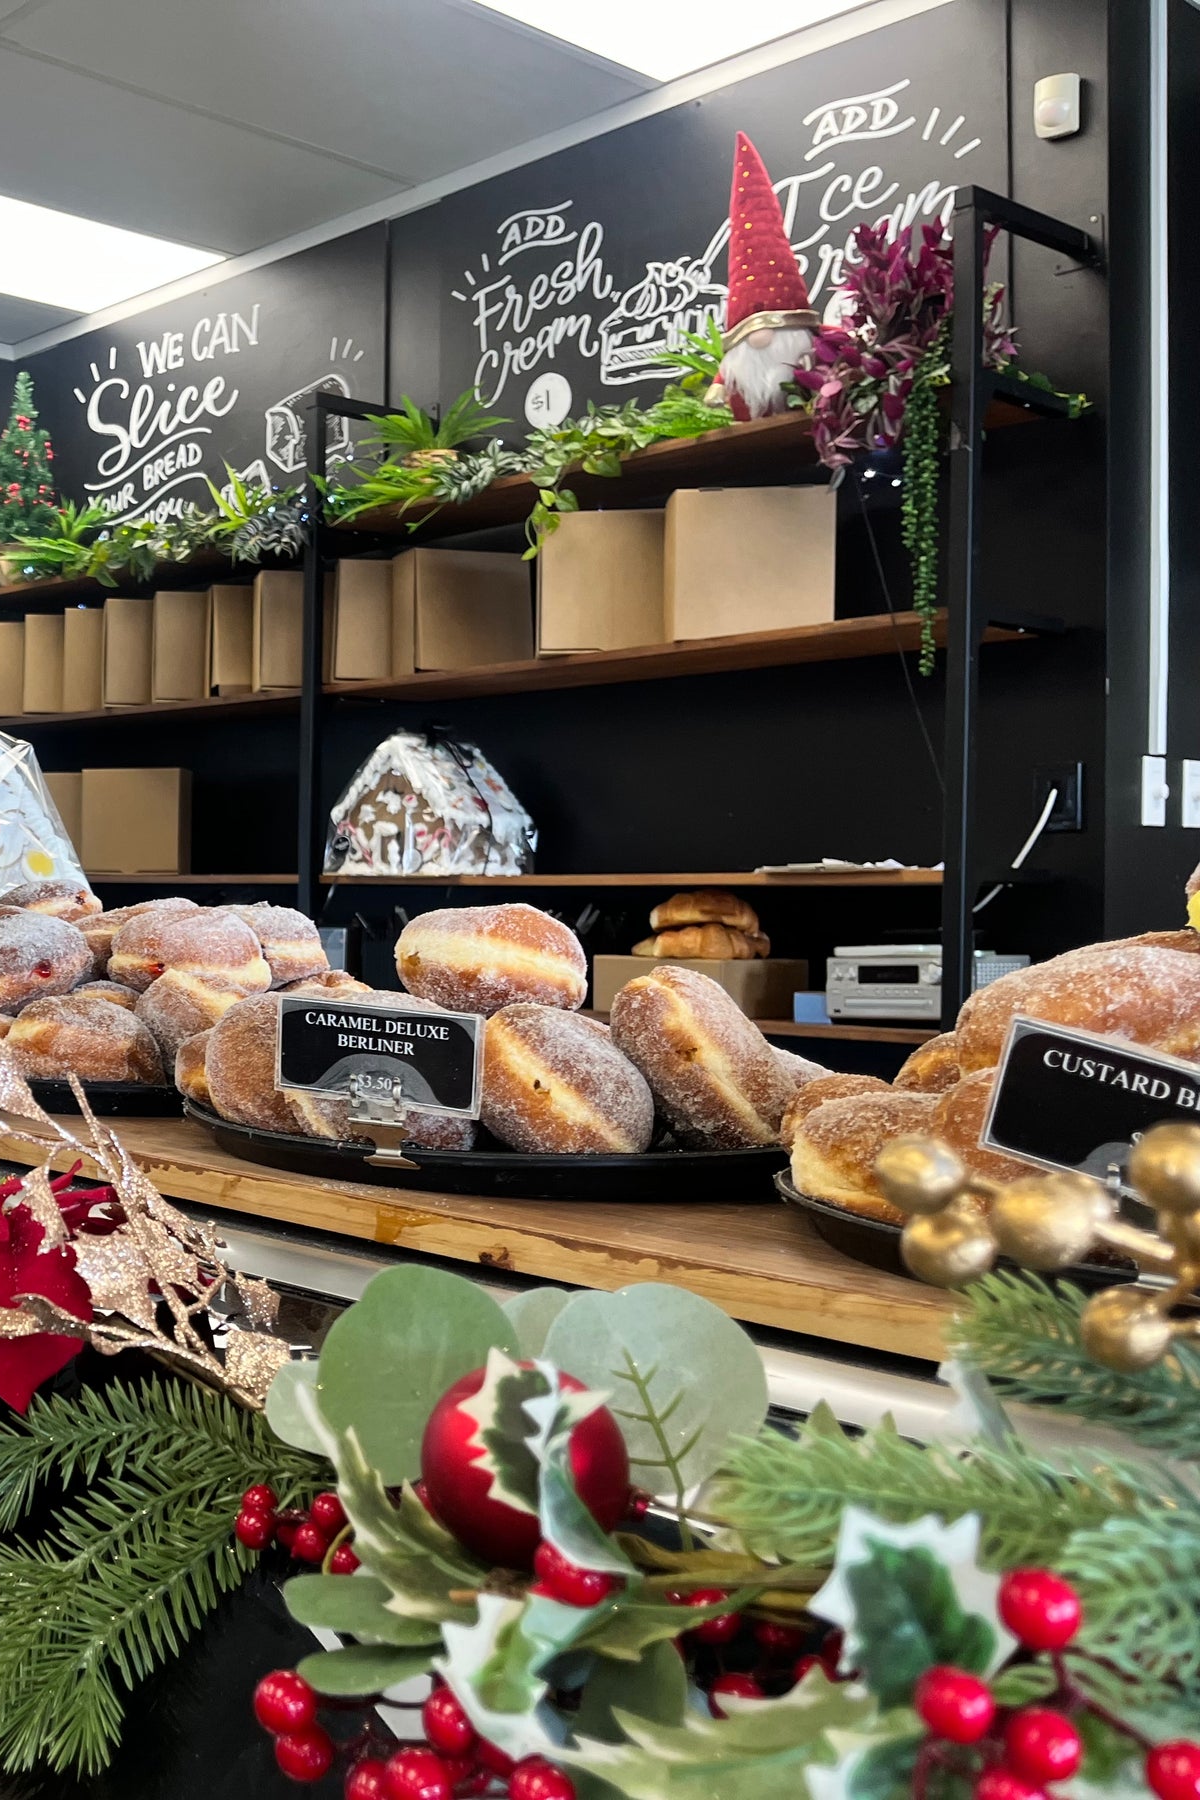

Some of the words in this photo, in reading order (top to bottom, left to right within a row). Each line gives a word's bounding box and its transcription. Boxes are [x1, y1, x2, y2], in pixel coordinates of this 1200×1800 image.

[811, 98, 899, 145] ADD
[772, 162, 899, 251] Ice
[502, 214, 564, 250] ADD
[472, 221, 614, 351] Fresh
[136, 332, 185, 378] WE
[191, 304, 260, 362] CAN
[87, 376, 239, 476] Slice
[142, 443, 203, 491] BREAD
[305, 1011, 381, 1033] CARAMEL
[385, 1020, 450, 1041] DELUXE
[337, 1033, 414, 1056] BERLINER
[356, 1073, 393, 1091] $3.50
[1043, 1049, 1171, 1099] CUSTARD
[1176, 1087, 1200, 1111] B
